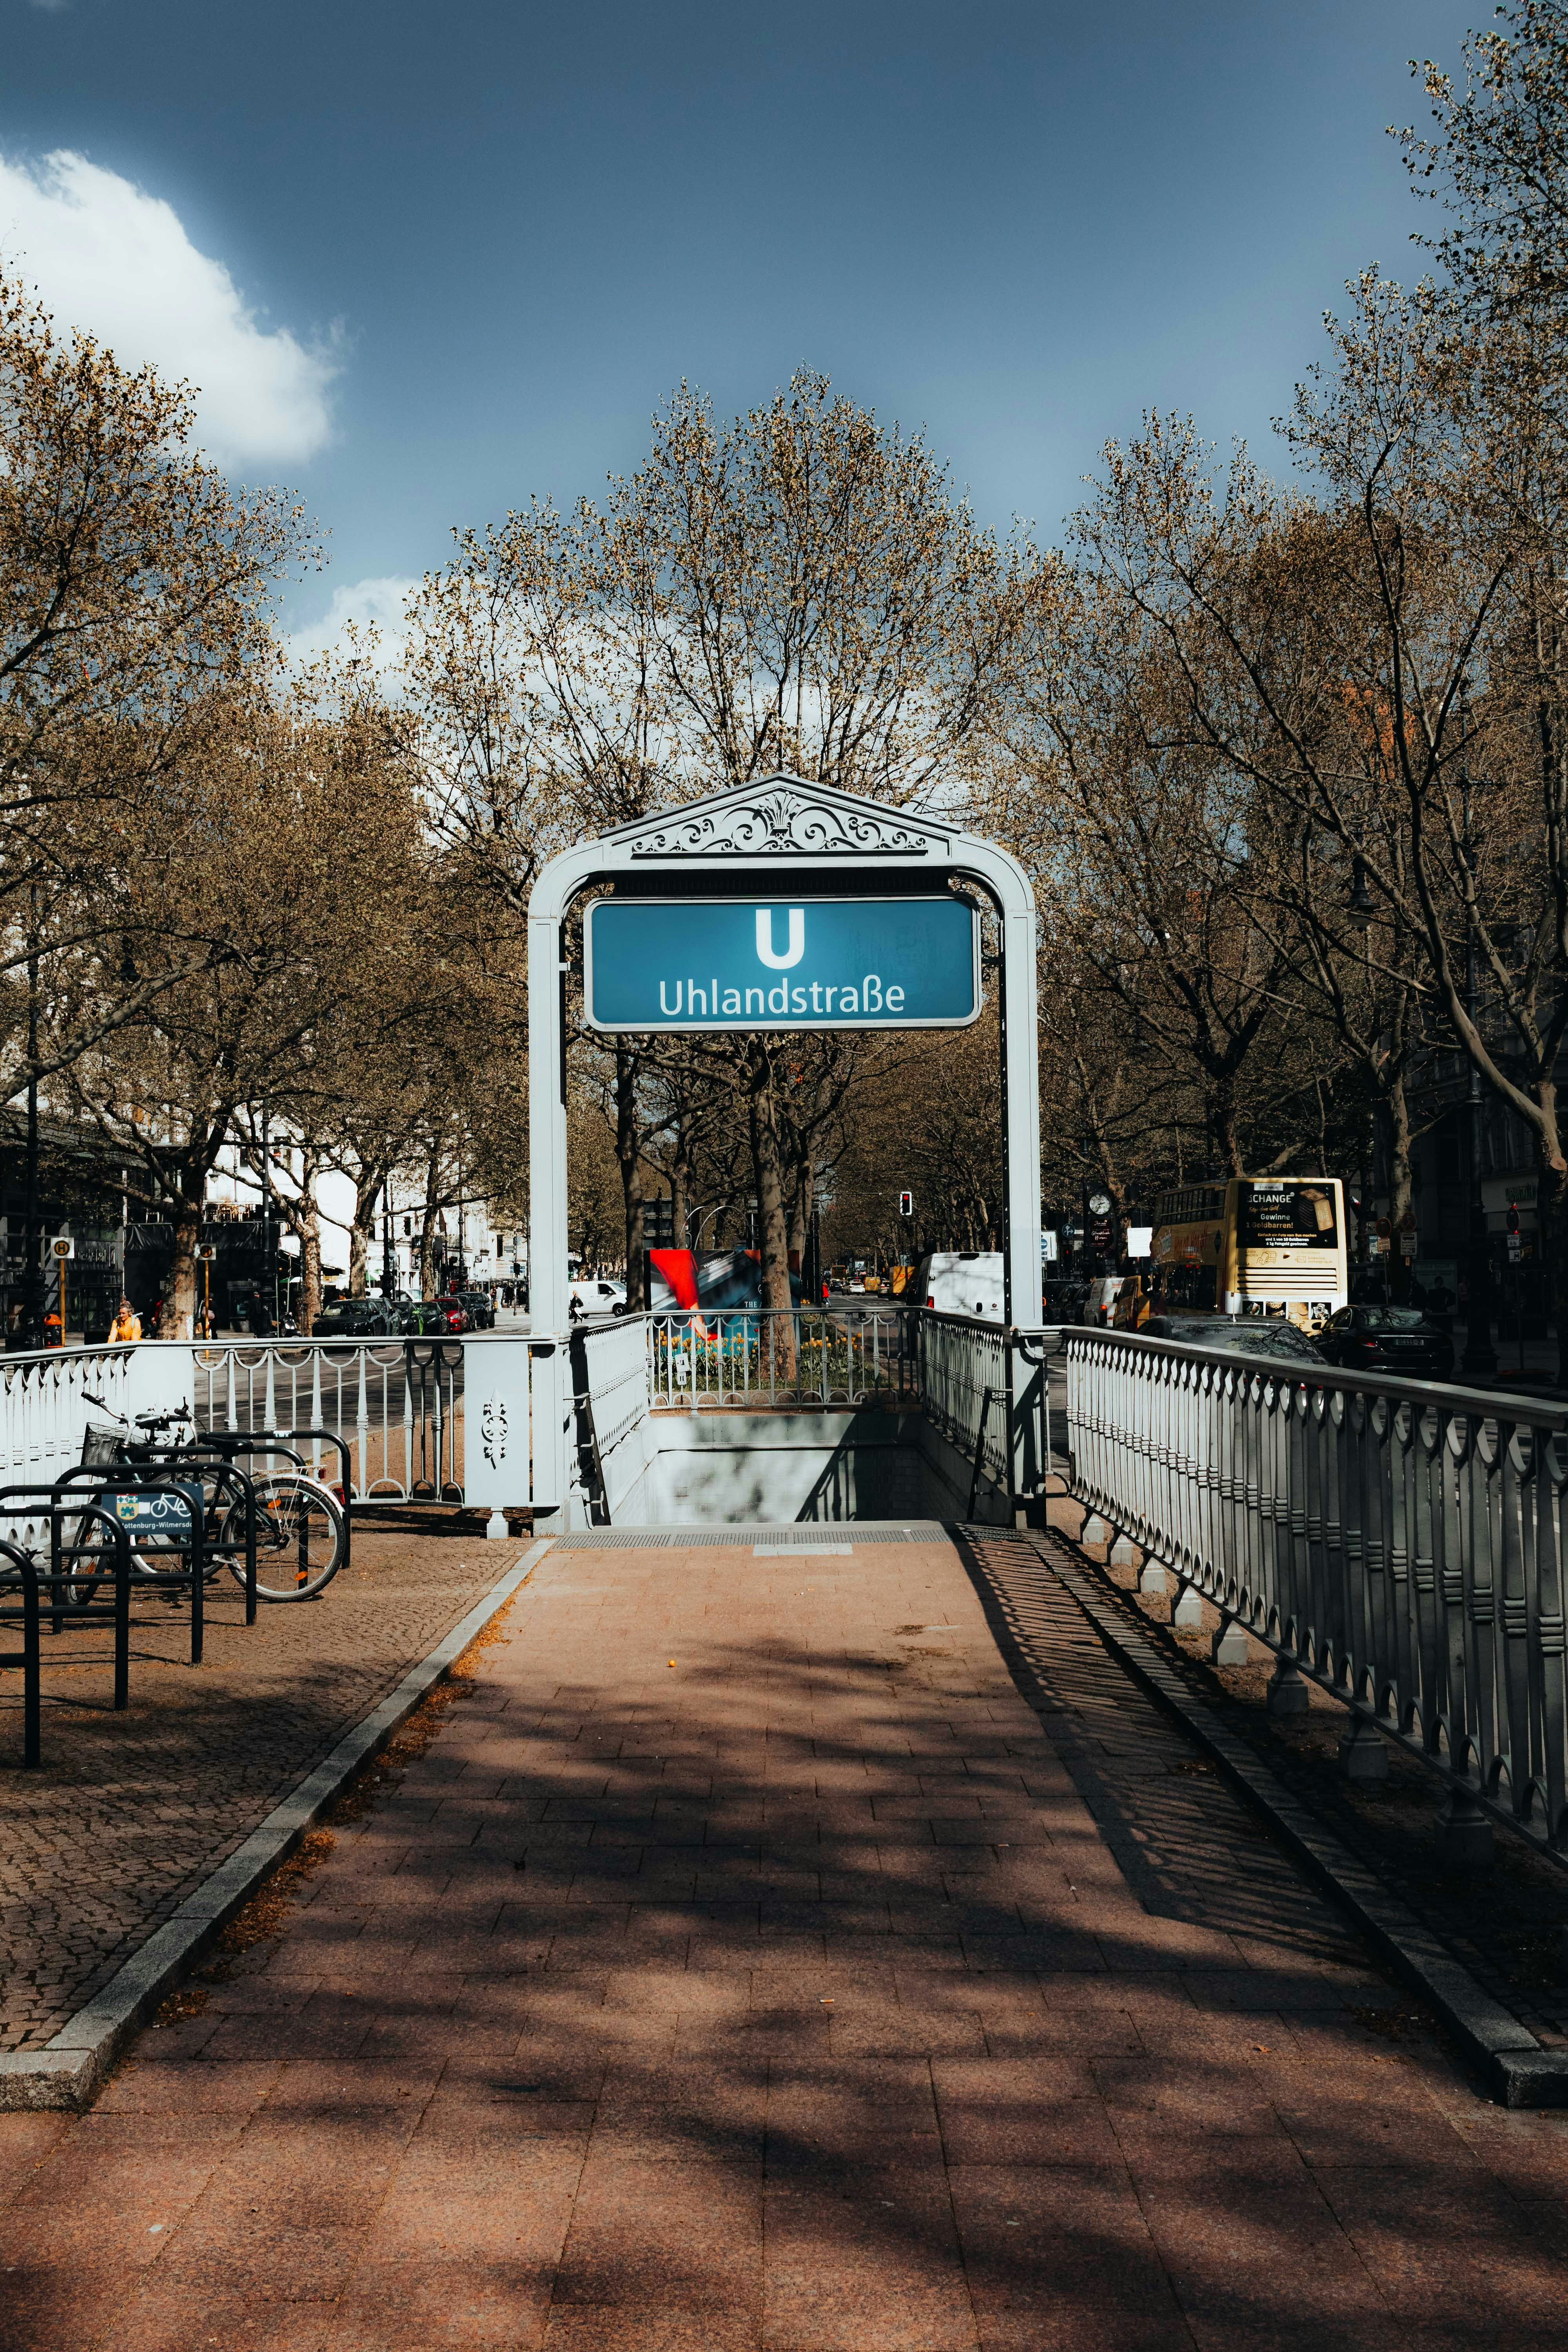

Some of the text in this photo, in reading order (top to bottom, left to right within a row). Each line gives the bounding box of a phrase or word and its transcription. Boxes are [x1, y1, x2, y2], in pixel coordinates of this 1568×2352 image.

[756, 908, 805, 970] U
[660, 975, 905, 1015] Uhlandstraße
[58, 1244, 65, 1252] H
[703, 1258, 722, 1268] MAYBACH
